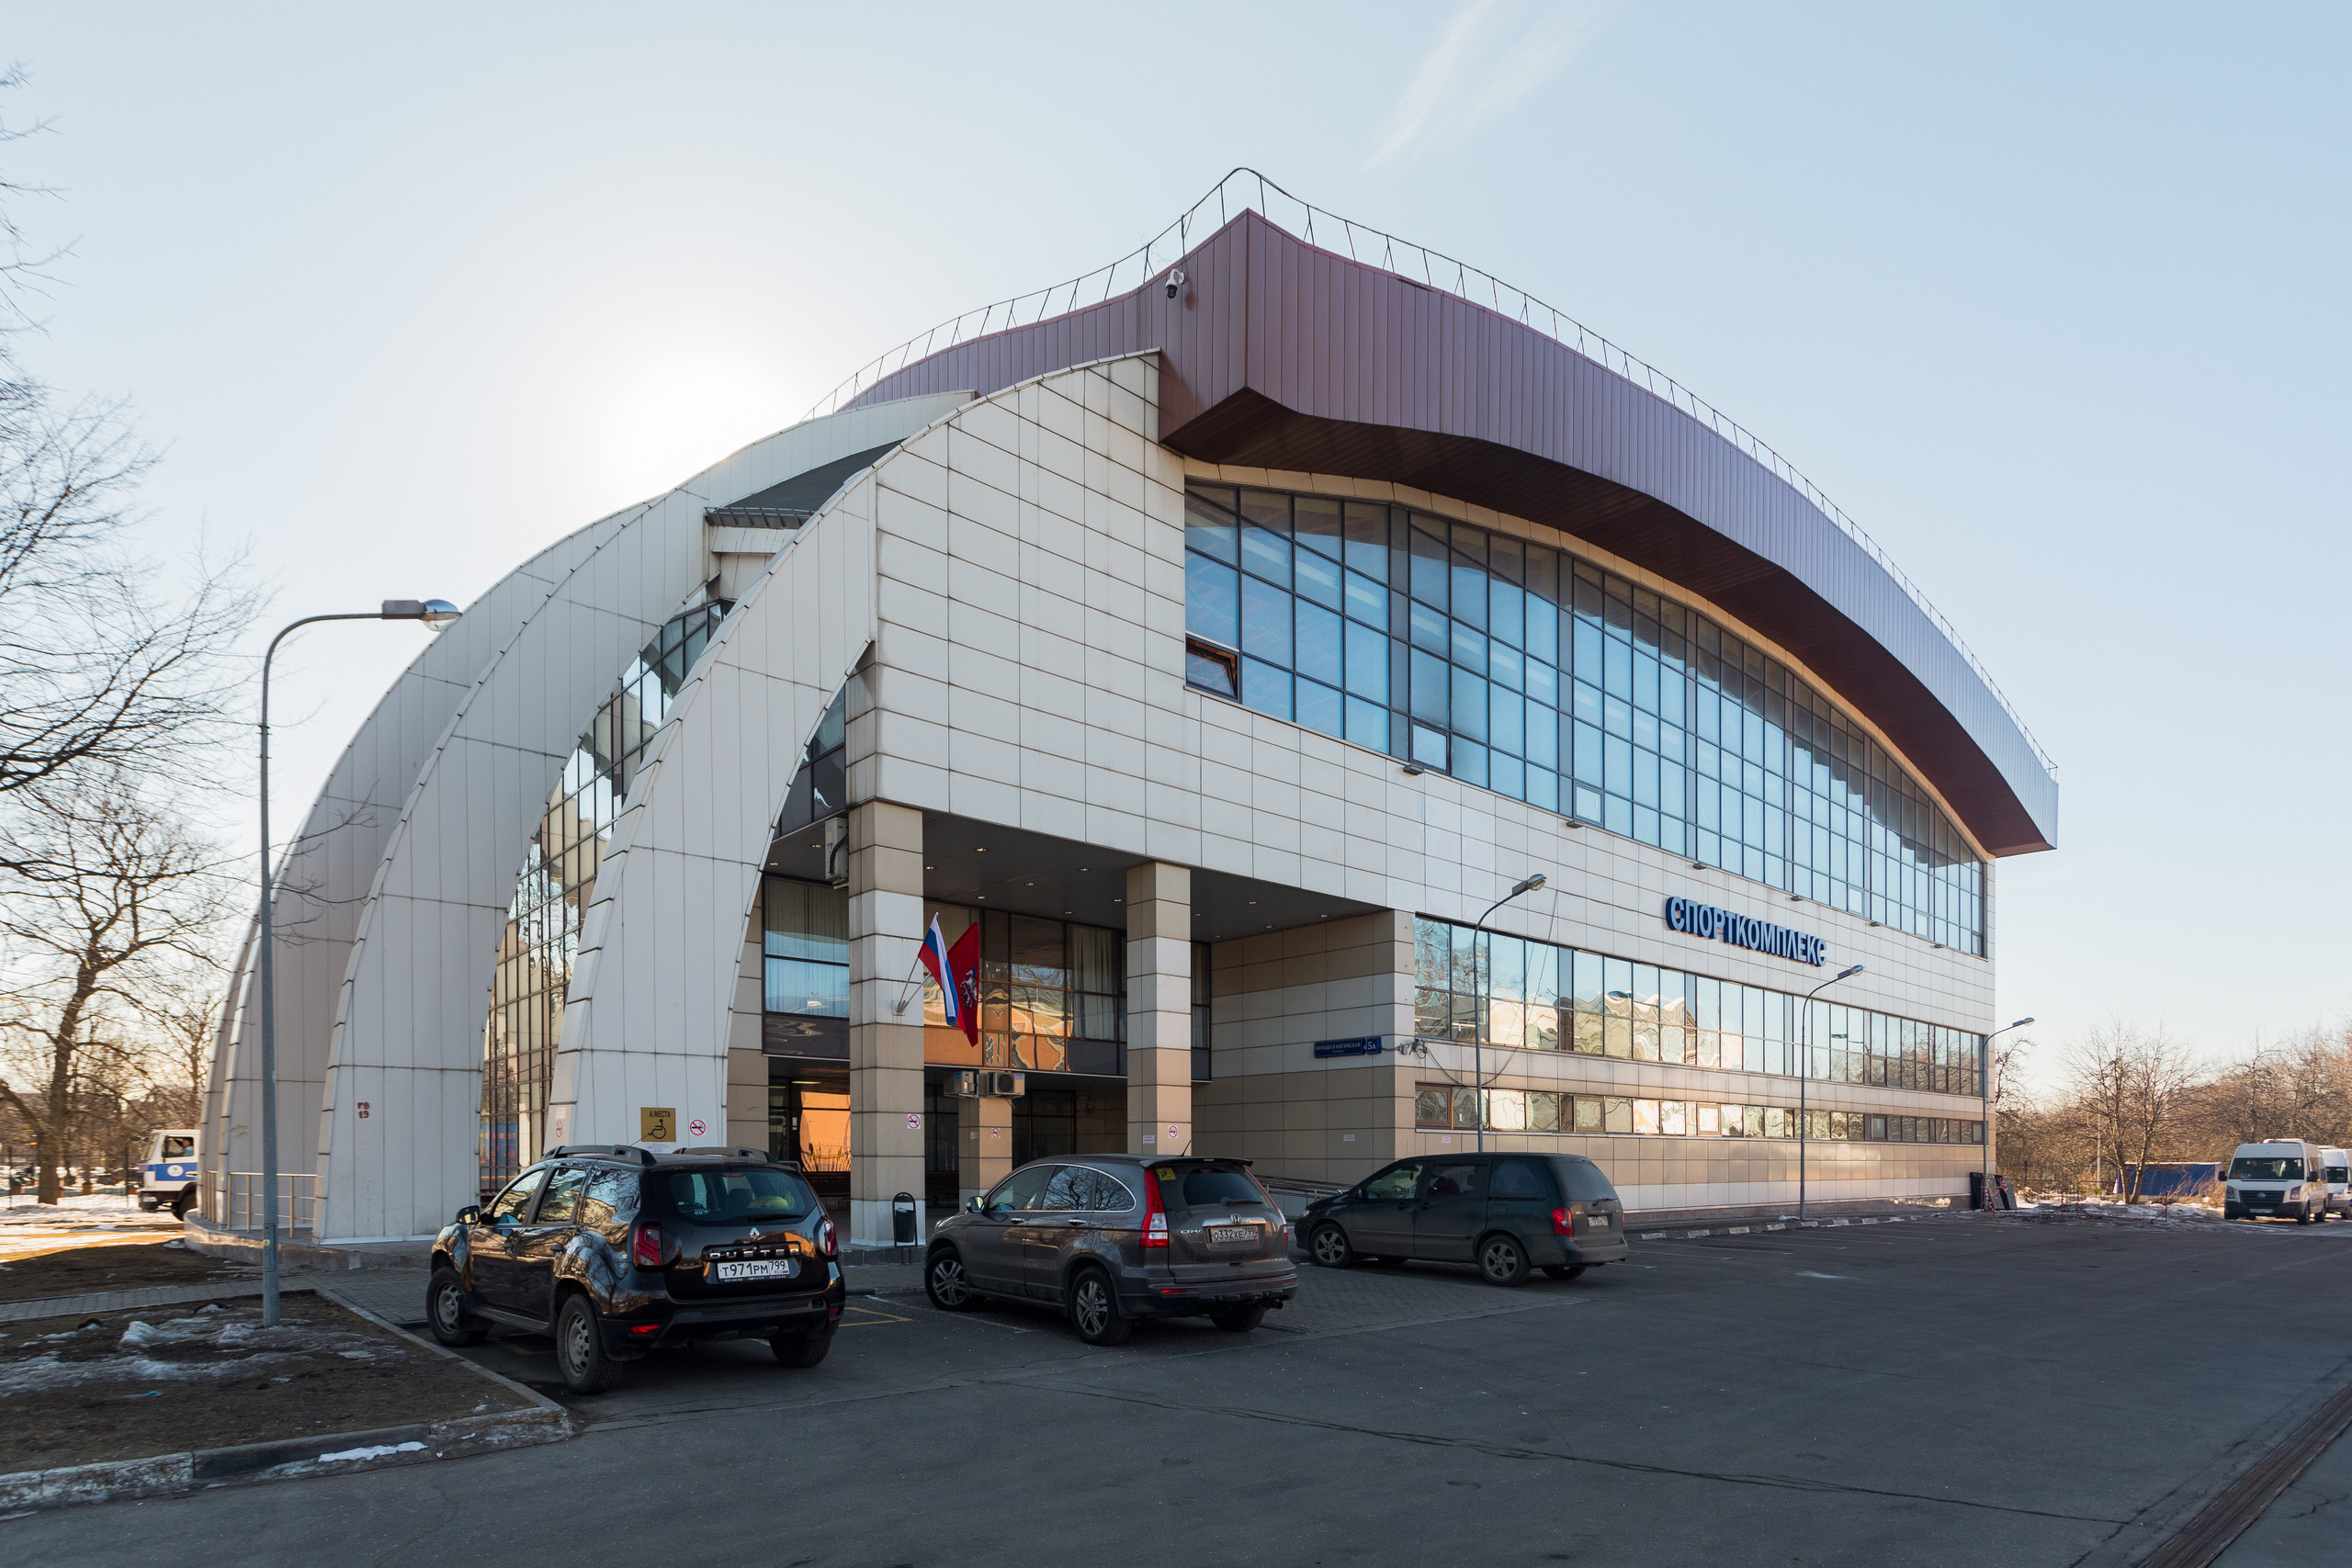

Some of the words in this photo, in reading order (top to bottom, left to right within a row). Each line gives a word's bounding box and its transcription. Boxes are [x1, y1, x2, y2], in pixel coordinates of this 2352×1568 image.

[1666, 897, 1826, 966] СПОРТКОМПЛЕКС
[358, 1111, 369, 1119] 19
[722, 1263, 769, 1277] Т971РМ
[769, 1261, 786, 1270] 799
